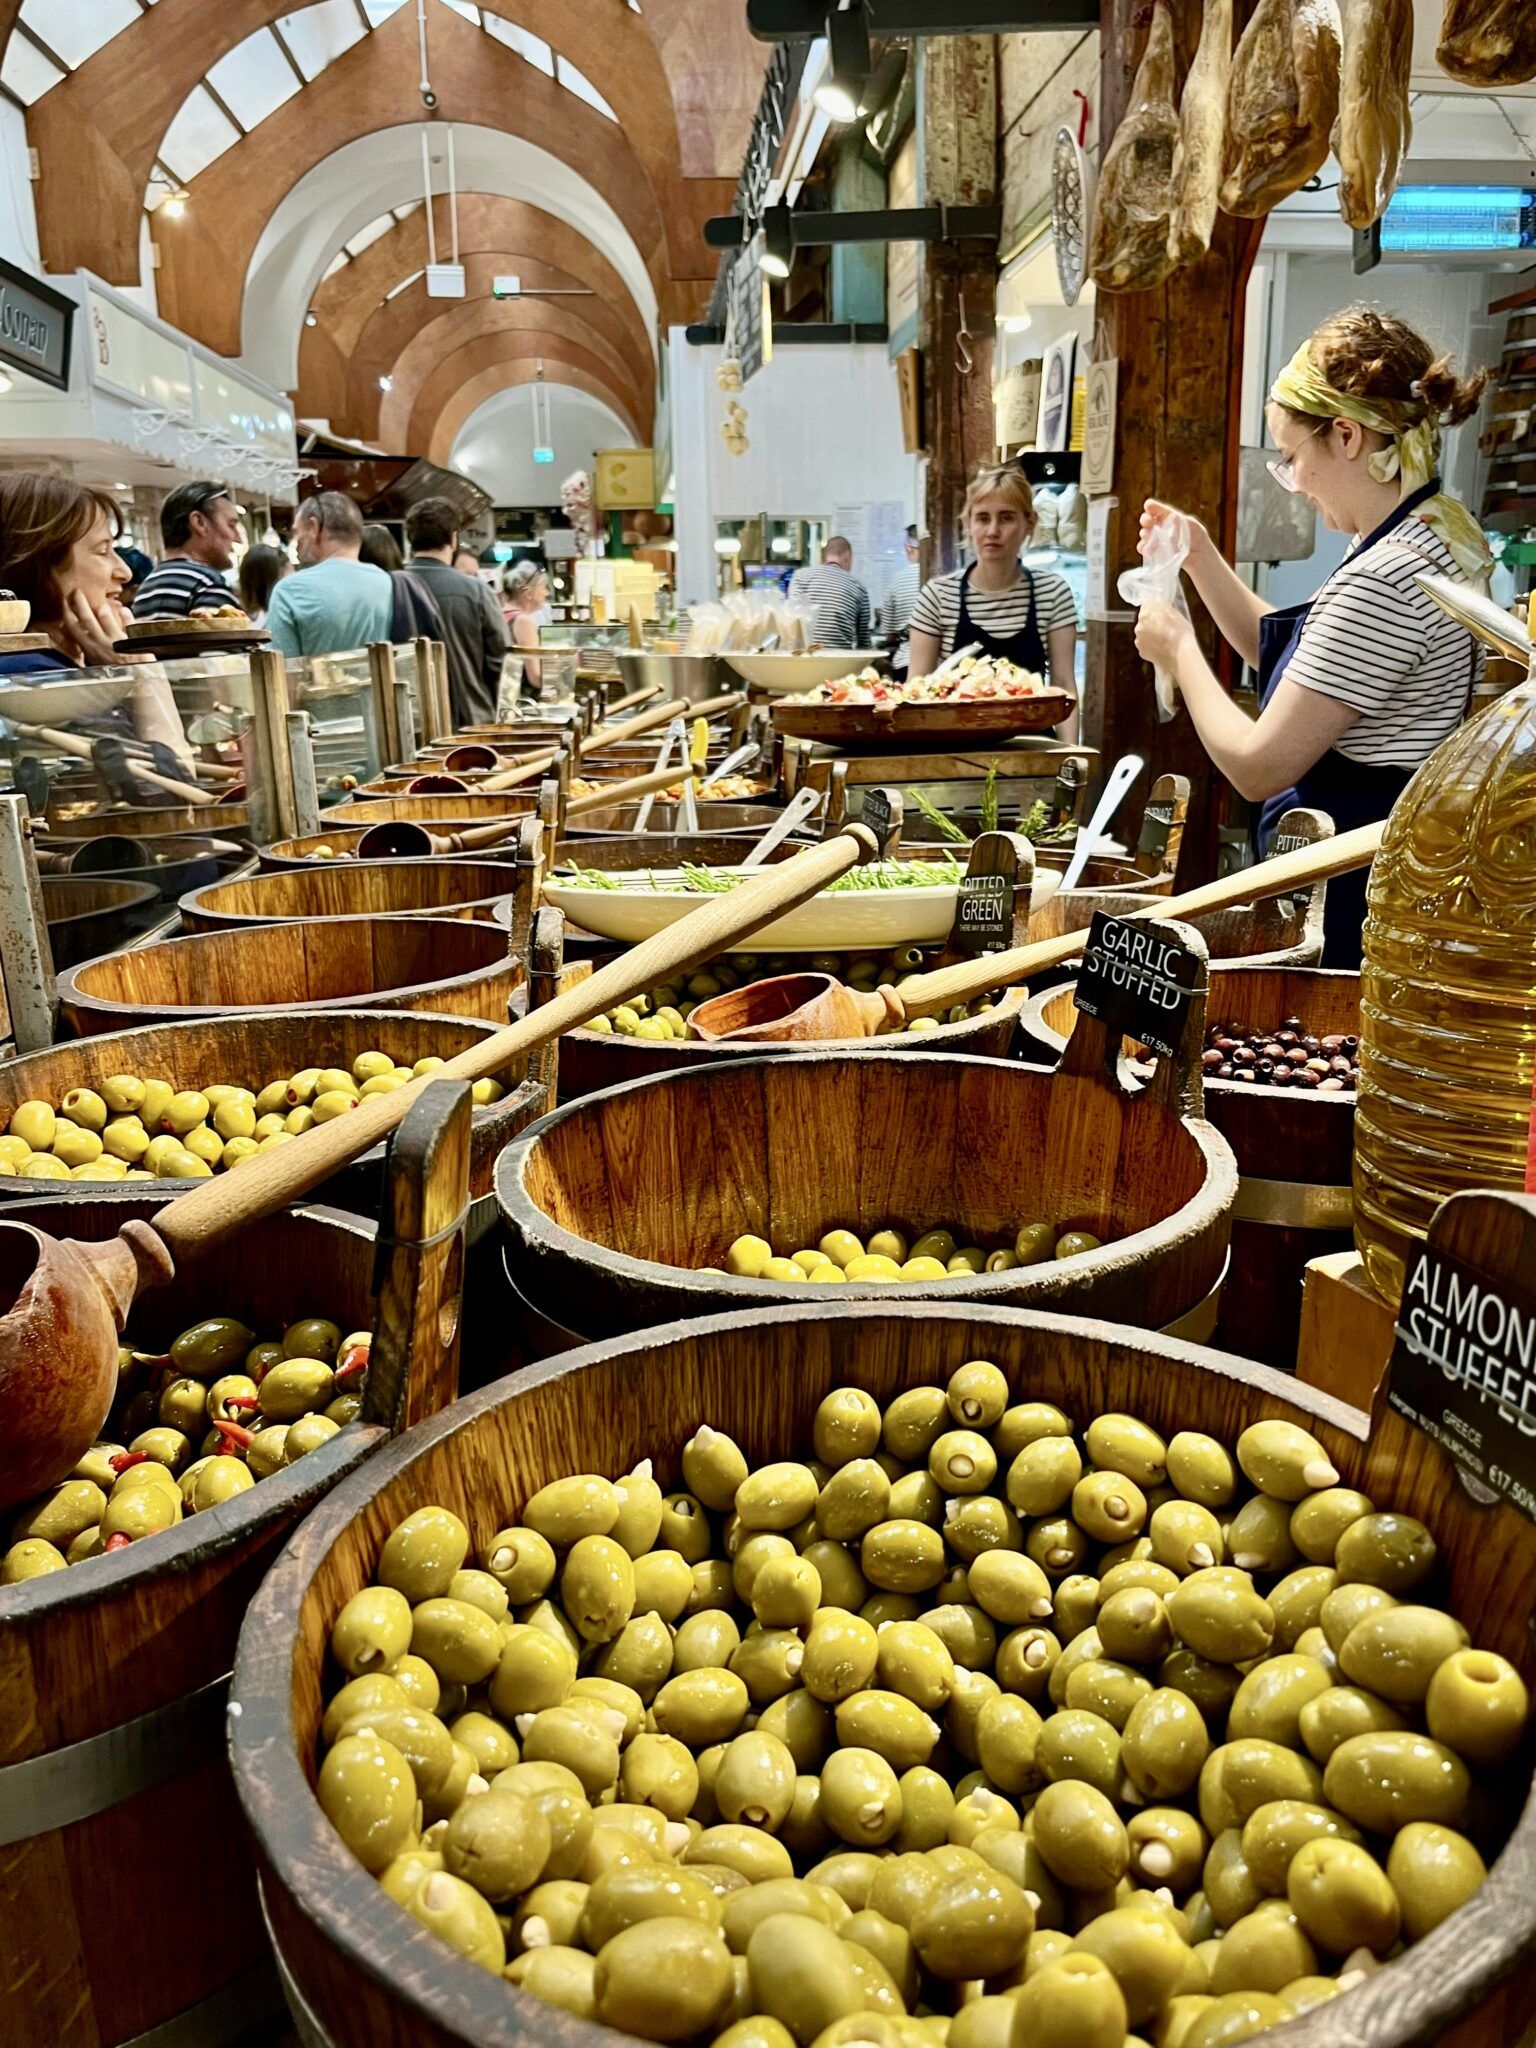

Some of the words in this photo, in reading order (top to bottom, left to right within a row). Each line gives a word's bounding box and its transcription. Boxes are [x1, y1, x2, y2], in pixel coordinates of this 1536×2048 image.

[964, 875, 1006, 898] PITTED
[962, 898, 1003, 921] GREEN
[1102, 921, 1182, 978] GARLIC
[1087, 946, 1181, 1010] STUFFED
[1075, 996, 1099, 1016] GREECE
[1407, 1254, 1536, 1374] ALMON
[1442, 1408, 1483, 1449] GREECE
